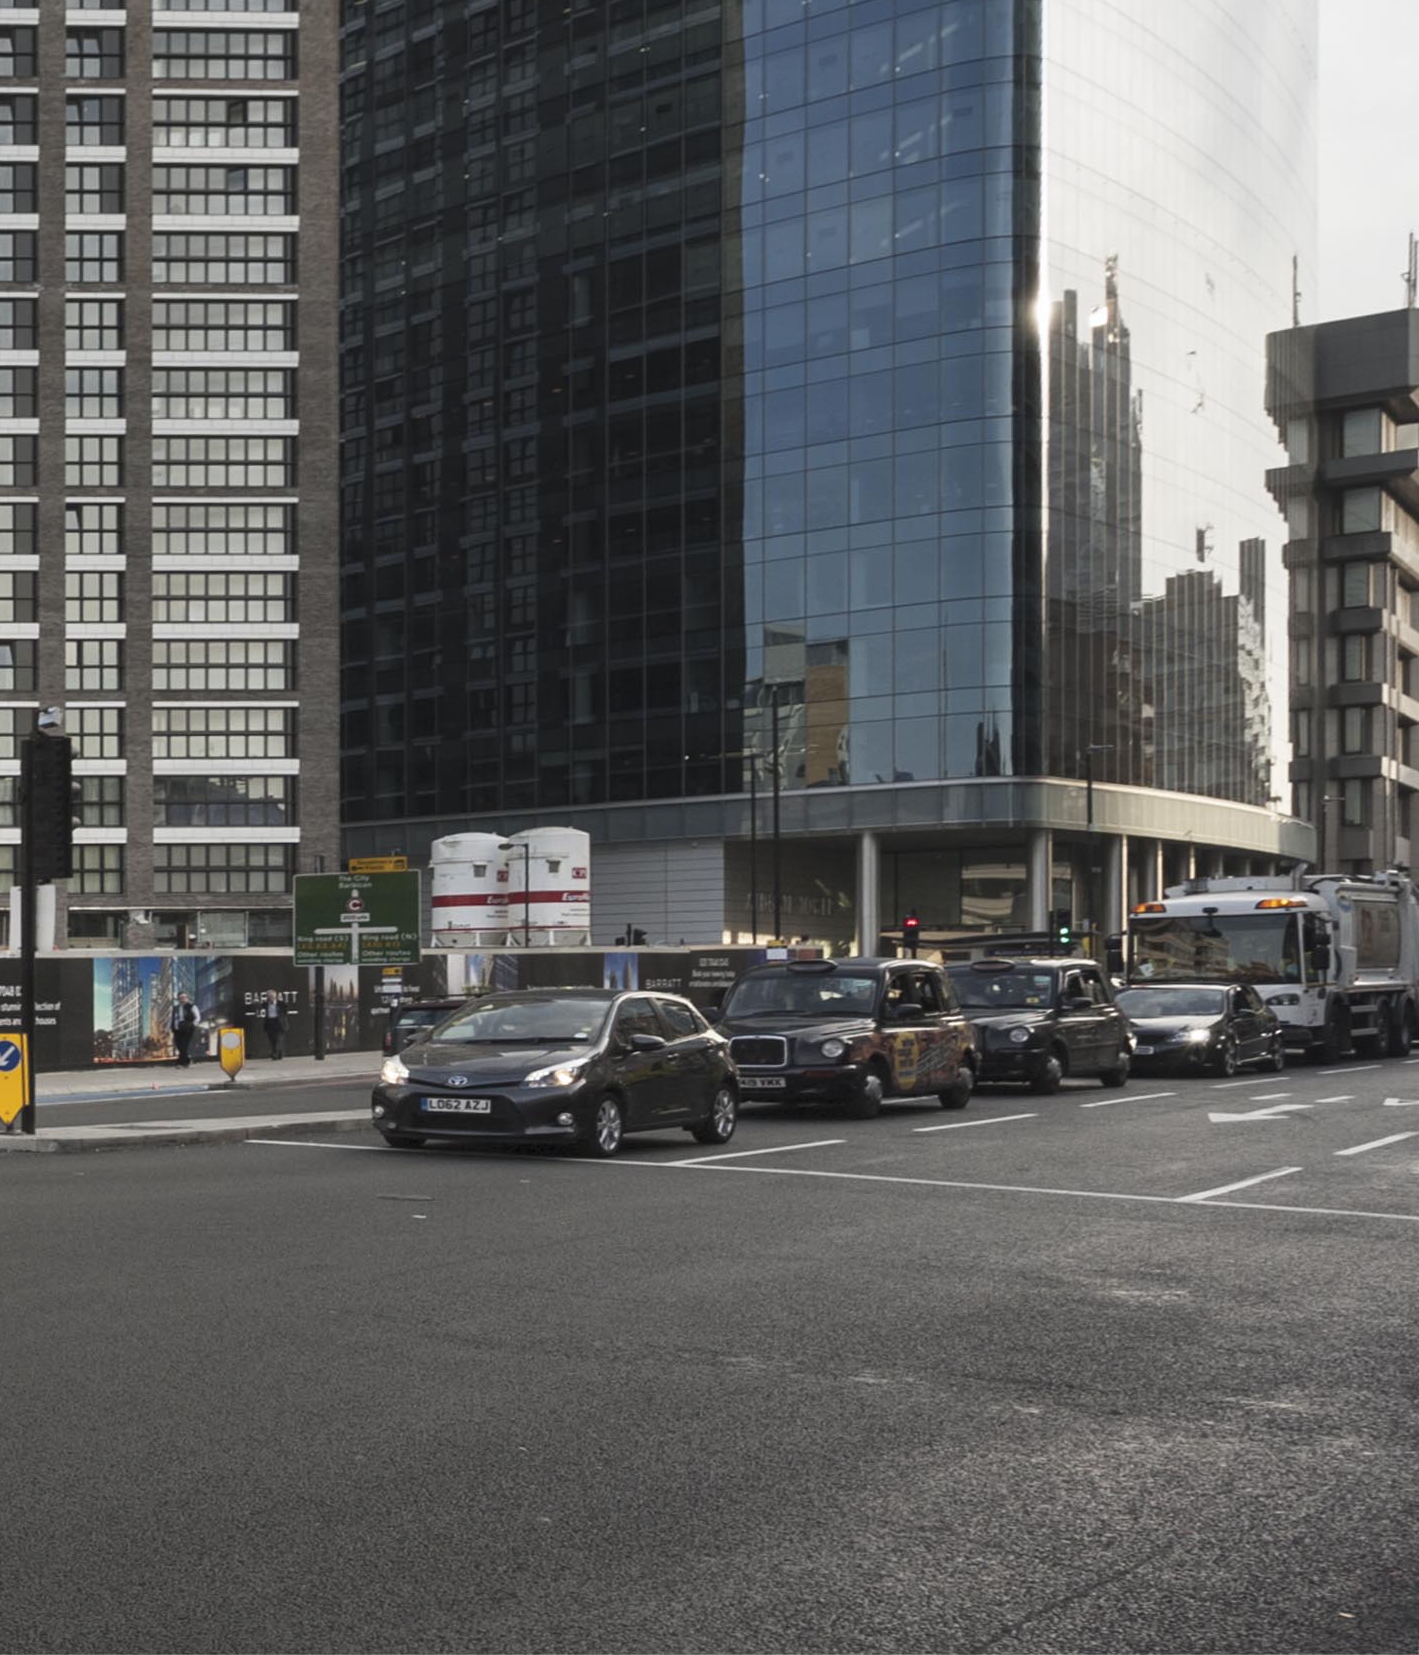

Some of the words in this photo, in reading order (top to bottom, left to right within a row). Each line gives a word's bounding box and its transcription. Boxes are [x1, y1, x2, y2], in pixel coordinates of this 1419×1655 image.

[353, 874, 370, 883] City
[244, 991, 299, 1005] BARATT
[465, 1100, 489, 1111] AZJ
